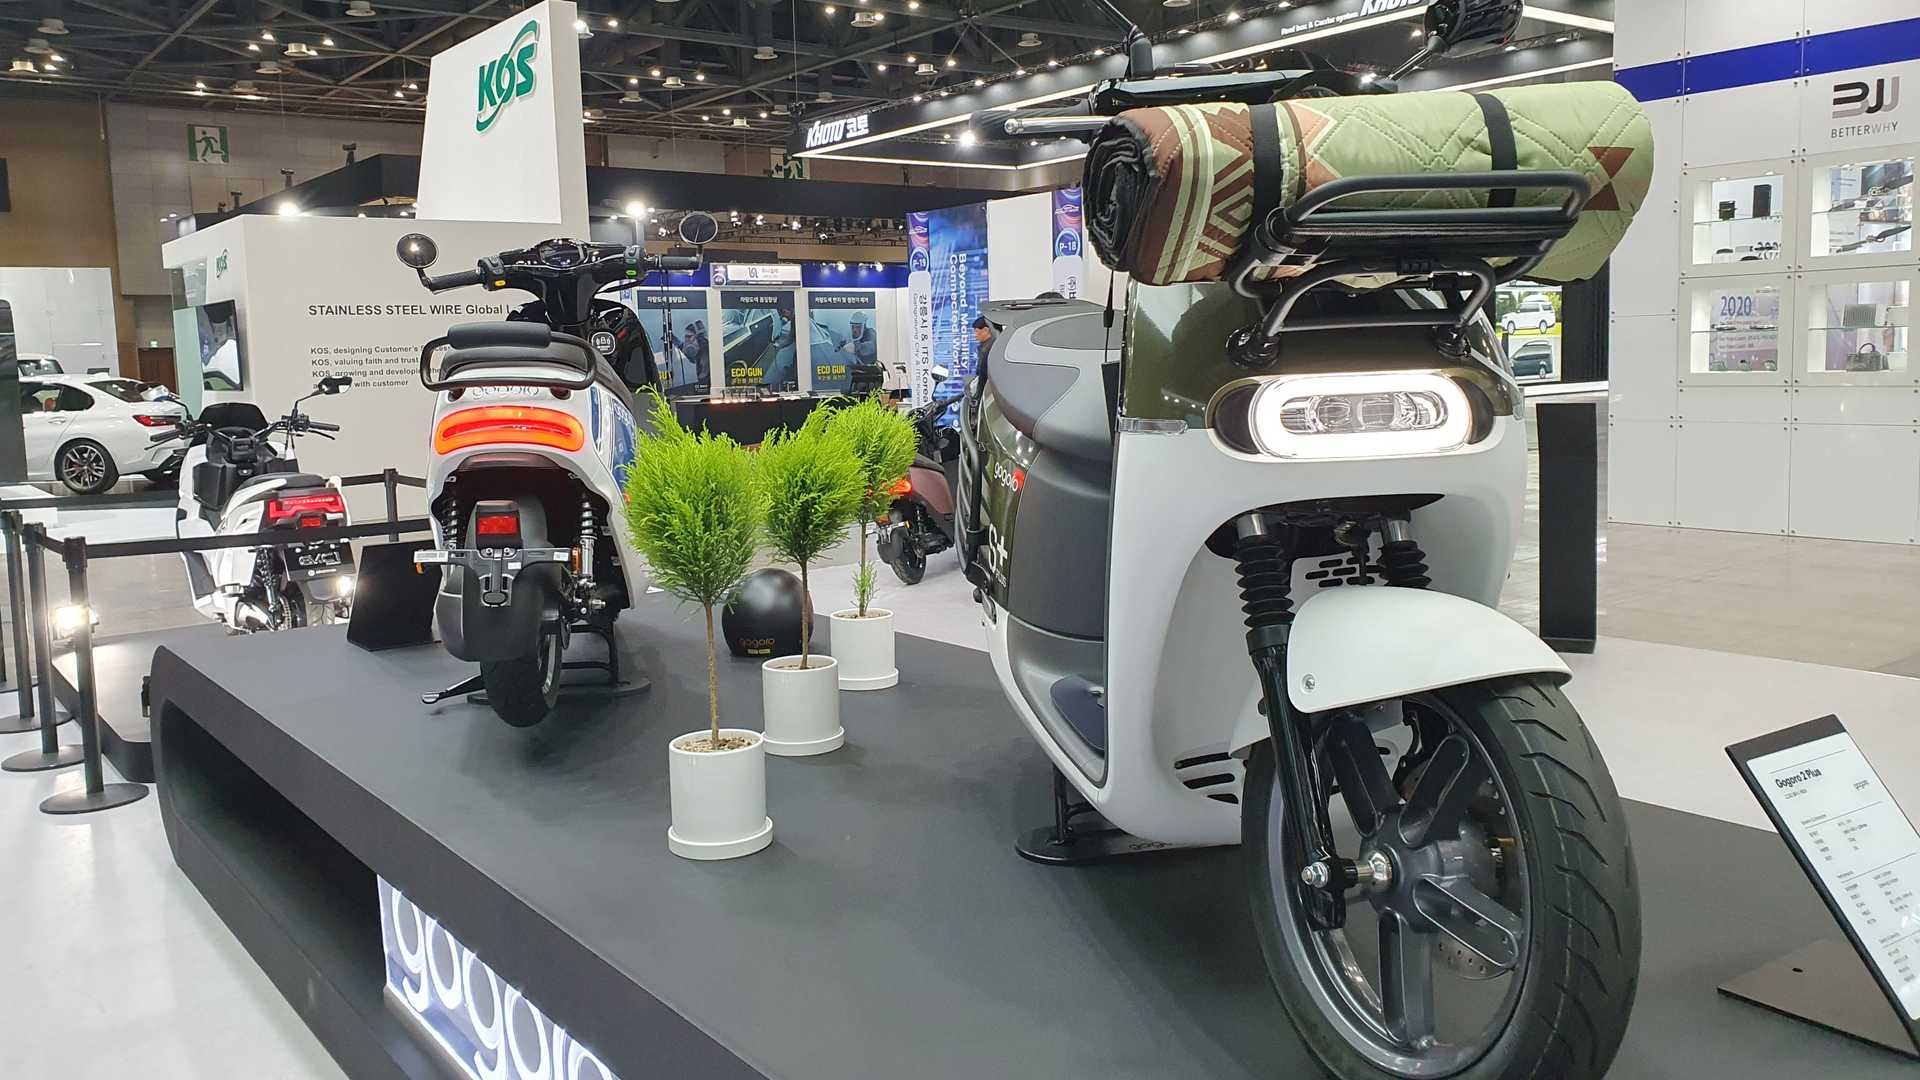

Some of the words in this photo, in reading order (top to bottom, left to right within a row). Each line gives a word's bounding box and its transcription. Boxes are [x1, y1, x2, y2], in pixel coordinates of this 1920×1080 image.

[478, 42, 535, 112] KOS
[805, 121, 847, 148] KHOTO
[846, 115, 869, 138] 코토
[1831, 121, 1898, 138] BETTERWHY
[1060, 241, 1077, 252] P-18
[958, 253, 968, 308] Beyond
[950, 253, 959, 333] Connected
[308, 304, 382, 316] STAINLESS
[386, 304, 427, 315] STEEL
[430, 304, 462, 315] WIRE
[465, 304, 503, 315] Global
[919, 292, 929, 329] 강릉시
[1720, 296, 1752, 316] 2020
[333, 346, 373, 355] designing
[374, 345, 418, 353] Customer's
[960, 312, 970, 370] Mobility
[334, 358, 364, 367] valuing
[365, 357, 383, 365] faith
[921, 346, 929, 365] ITS
[952, 335, 961, 377] World
[335, 369, 367, 377] growing
[369, 368, 384, 376] and
[731, 367, 746, 377] ECO
[747, 367, 763, 377] GUN
[816, 365, 831, 375] ECO
[831, 364, 847, 375] GUN
[354, 380, 371, 388] with
[993, 462, 1019, 492] gogoro
[1775, 775, 1802, 788] Gogoro
[1799, 770, 1808, 781] 2
[1805, 768, 1823, 779] Plus
